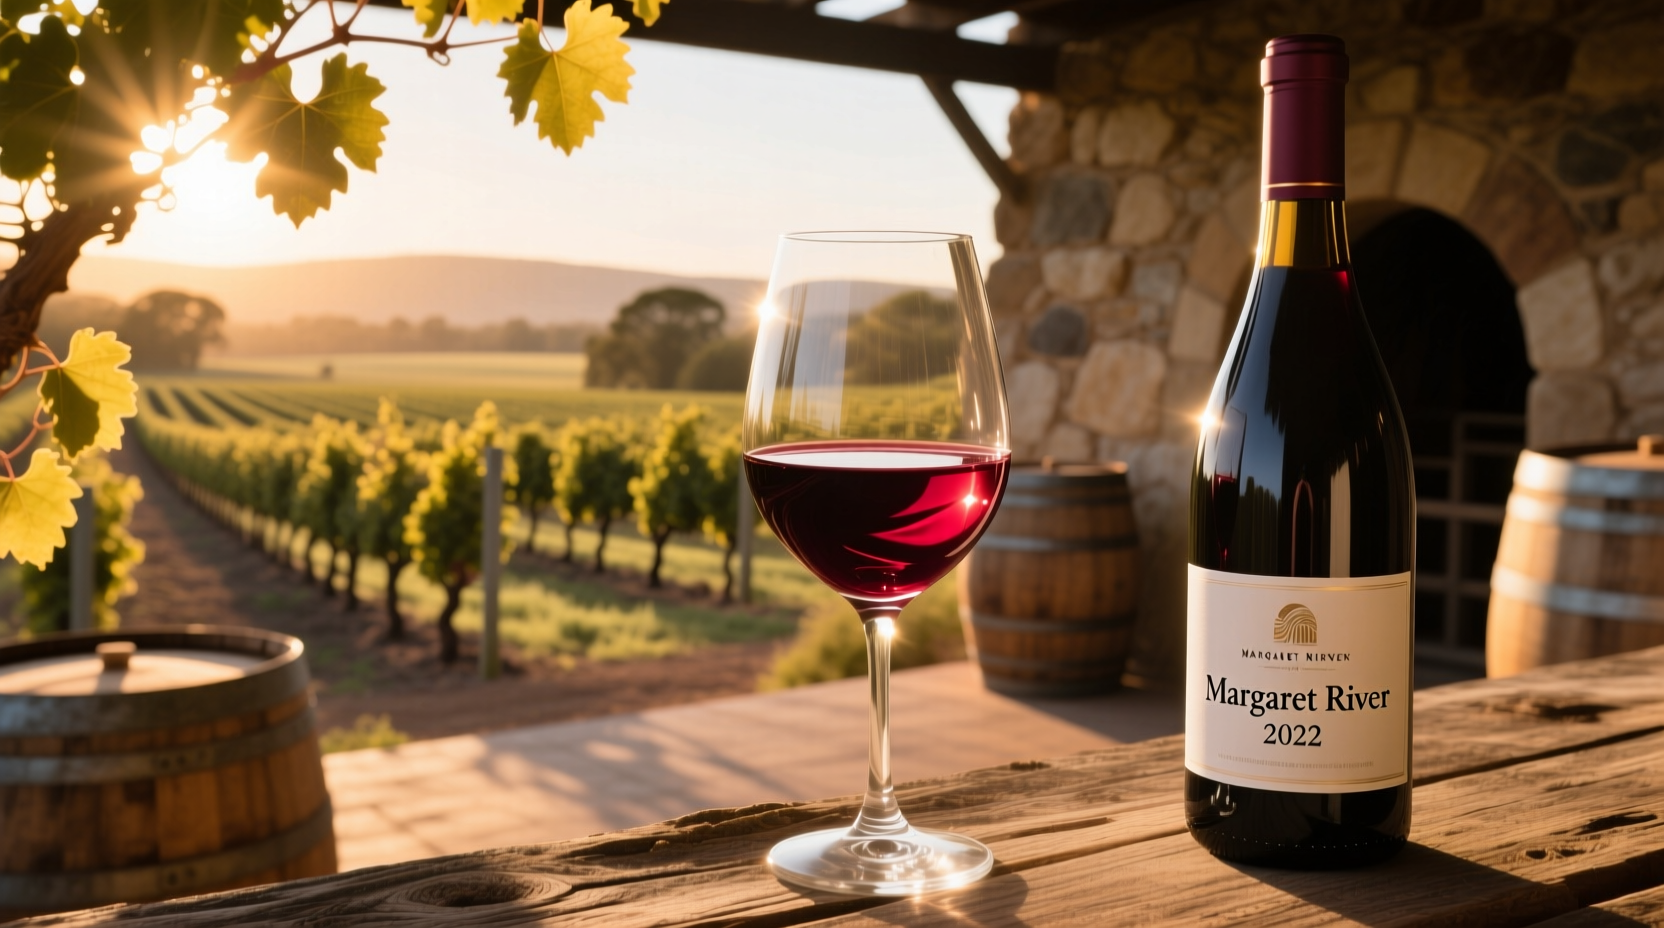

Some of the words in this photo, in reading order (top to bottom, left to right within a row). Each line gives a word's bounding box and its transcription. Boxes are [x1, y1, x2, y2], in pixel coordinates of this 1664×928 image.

[1205, 674, 1317, 717] Margaret
[1325, 685, 1390, 712] River
[1263, 723, 1322, 747] 2022
